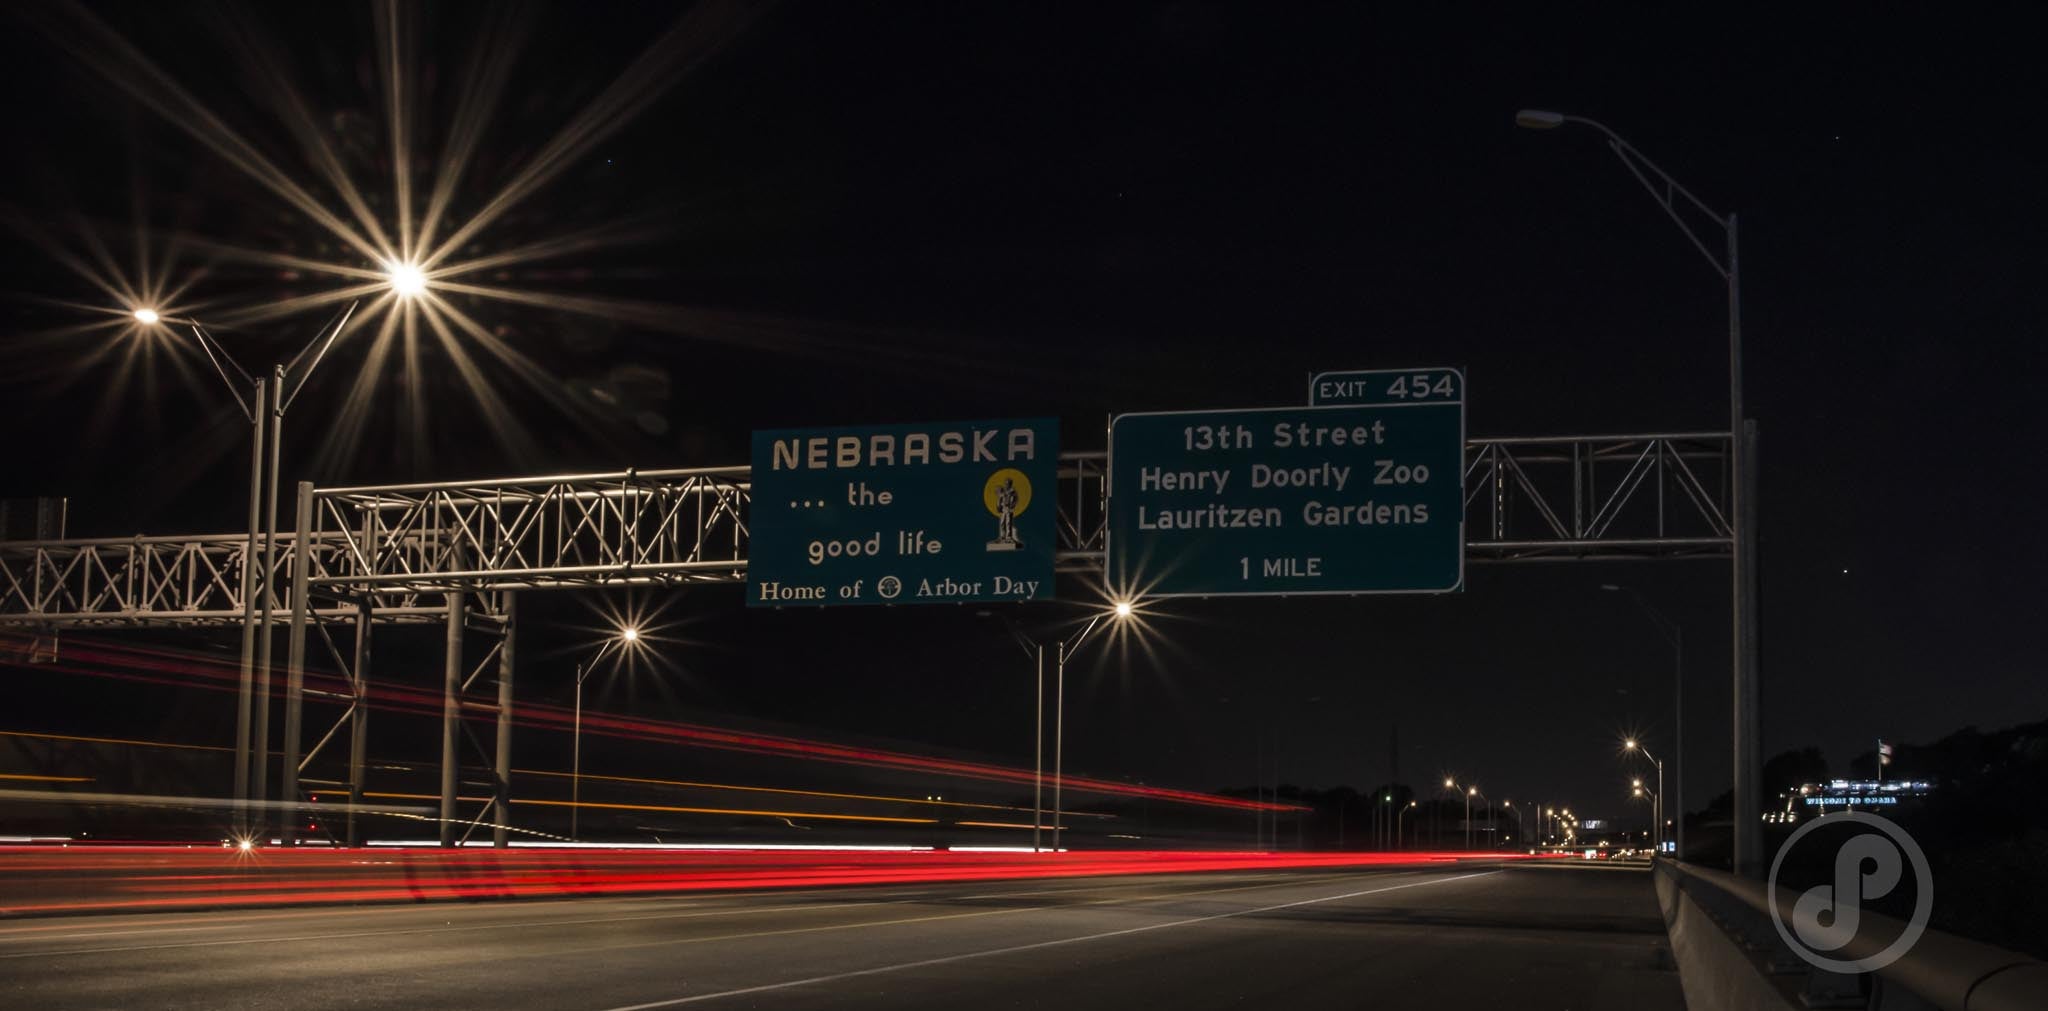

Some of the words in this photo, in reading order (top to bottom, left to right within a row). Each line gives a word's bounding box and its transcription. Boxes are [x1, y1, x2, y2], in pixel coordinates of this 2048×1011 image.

[1319, 380, 1367, 399] EXIT
[1386, 374, 1455, 399] 454
[772, 428, 1035, 471] NEBRASKA
[1183, 425, 1254, 451] 13th
[1273, 419, 1387, 449] Street
[1140, 466, 1231, 495] Henry
[1250, 461, 1351, 492] Doorly
[1373, 459, 1430, 486] Zoo
[847, 481, 894, 507] the
[1138, 504, 1283, 531] Lauritzen
[1302, 500, 1430, 527] Gardens
[807, 531, 881, 567] good
[899, 530, 943, 556] life
[1239, 556, 1250, 581] 1
[1262, 557, 1323, 578] MILE
[759, 581, 826, 601] Home
[839, 580, 864, 600] of
[916, 577, 982, 598] Arbor
[993, 575, 1040, 600] Day
